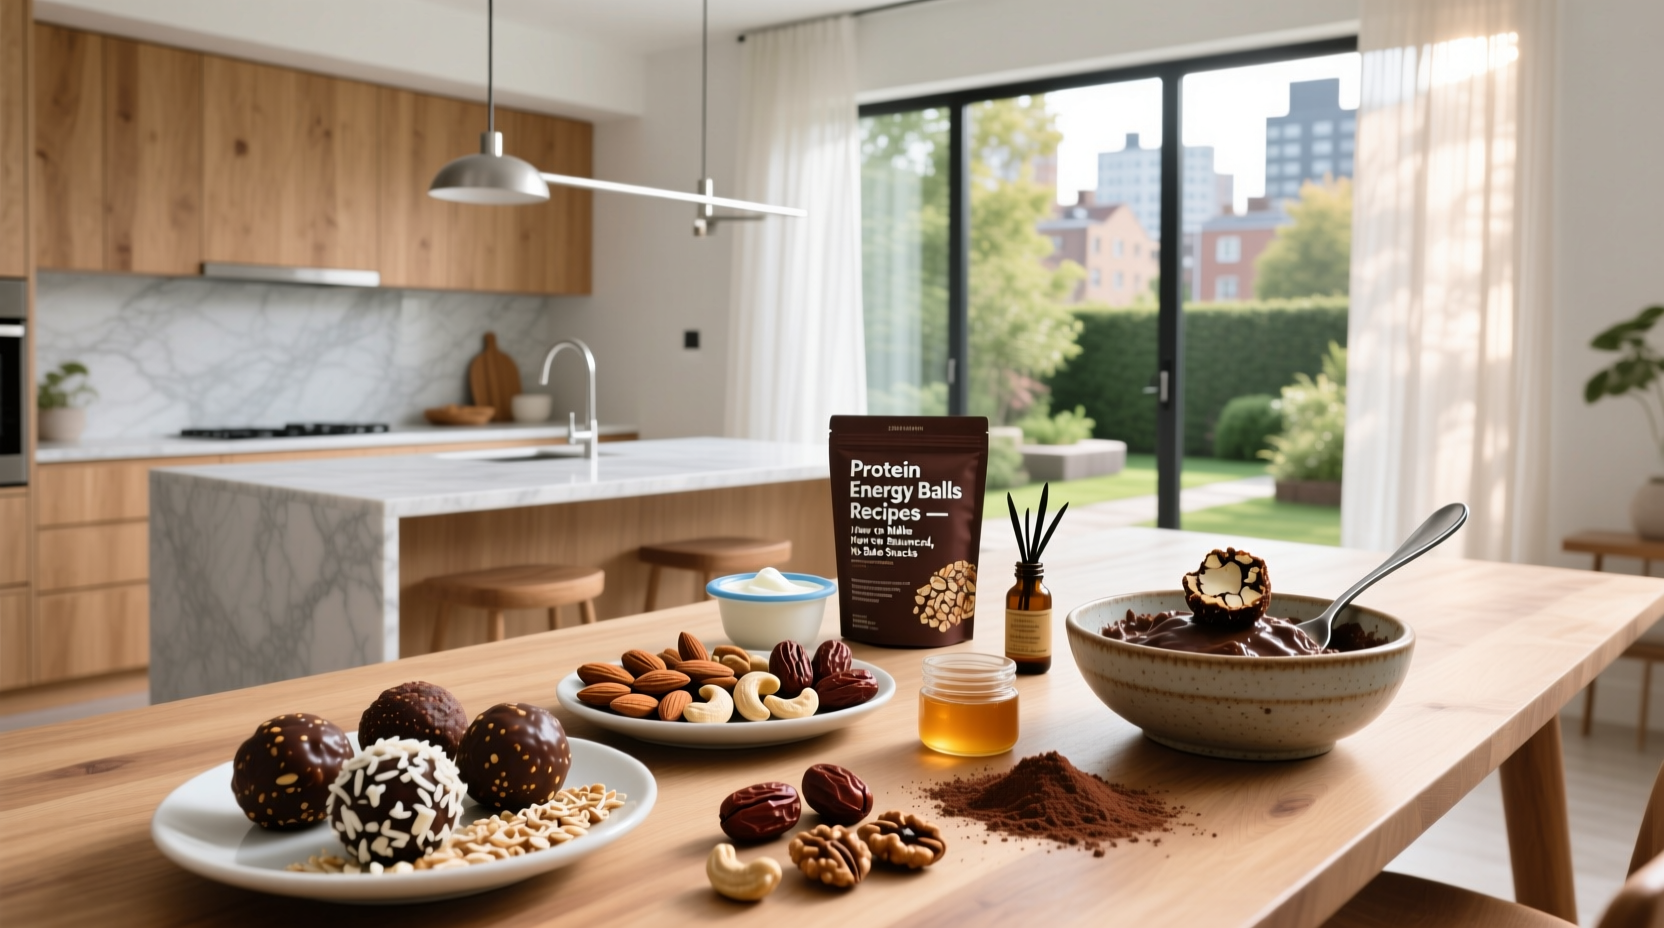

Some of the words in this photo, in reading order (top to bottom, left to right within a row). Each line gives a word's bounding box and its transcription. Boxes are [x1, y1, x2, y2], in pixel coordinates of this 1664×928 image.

[850, 459, 921, 478] Protein
[850, 480, 914, 504] Energy
[918, 480, 963, 499] Balls
[850, 502, 921, 525] Recipes
